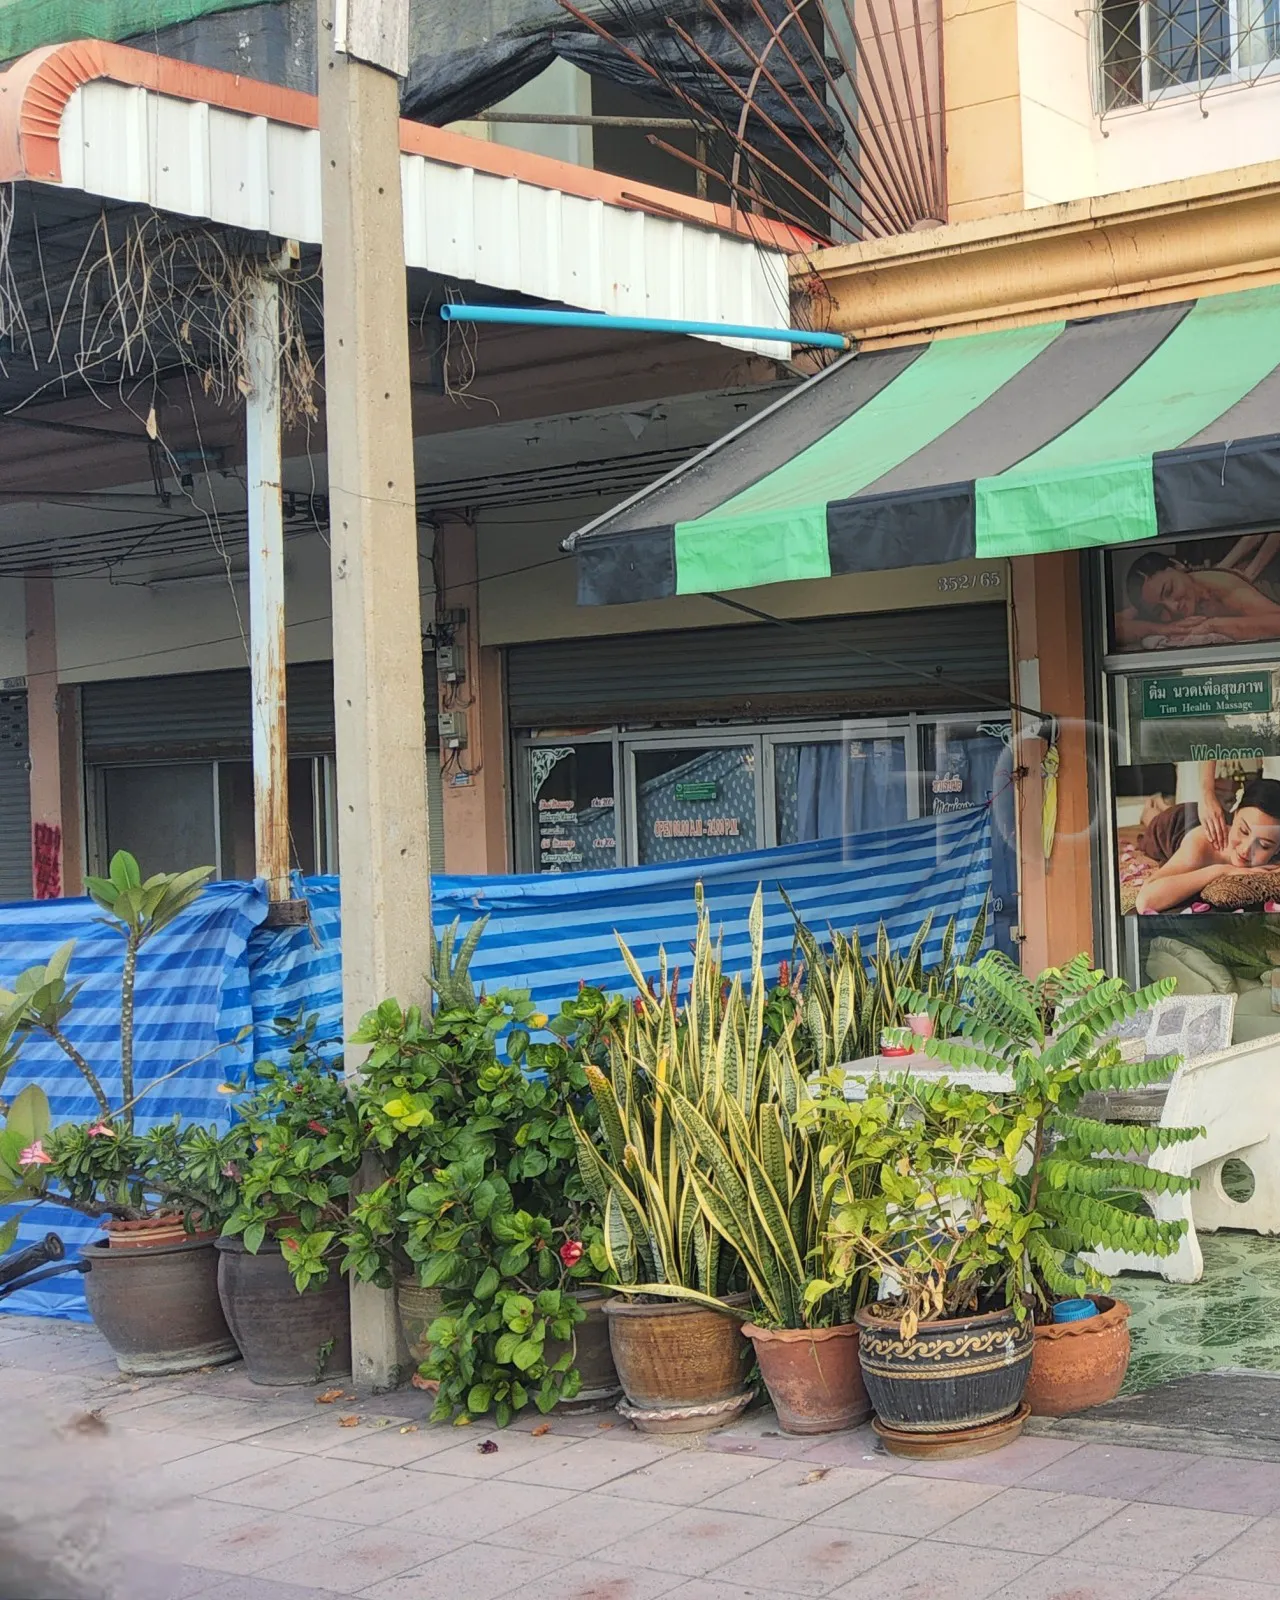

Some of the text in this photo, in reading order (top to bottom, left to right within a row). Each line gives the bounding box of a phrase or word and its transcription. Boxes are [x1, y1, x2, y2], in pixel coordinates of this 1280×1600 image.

[938, 572, 1000, 592] 352/65
[1173, 677, 1264, 700] นวดเพื่อสุขภาพ
[1159, 700, 1253, 714] Tim Health Massage
